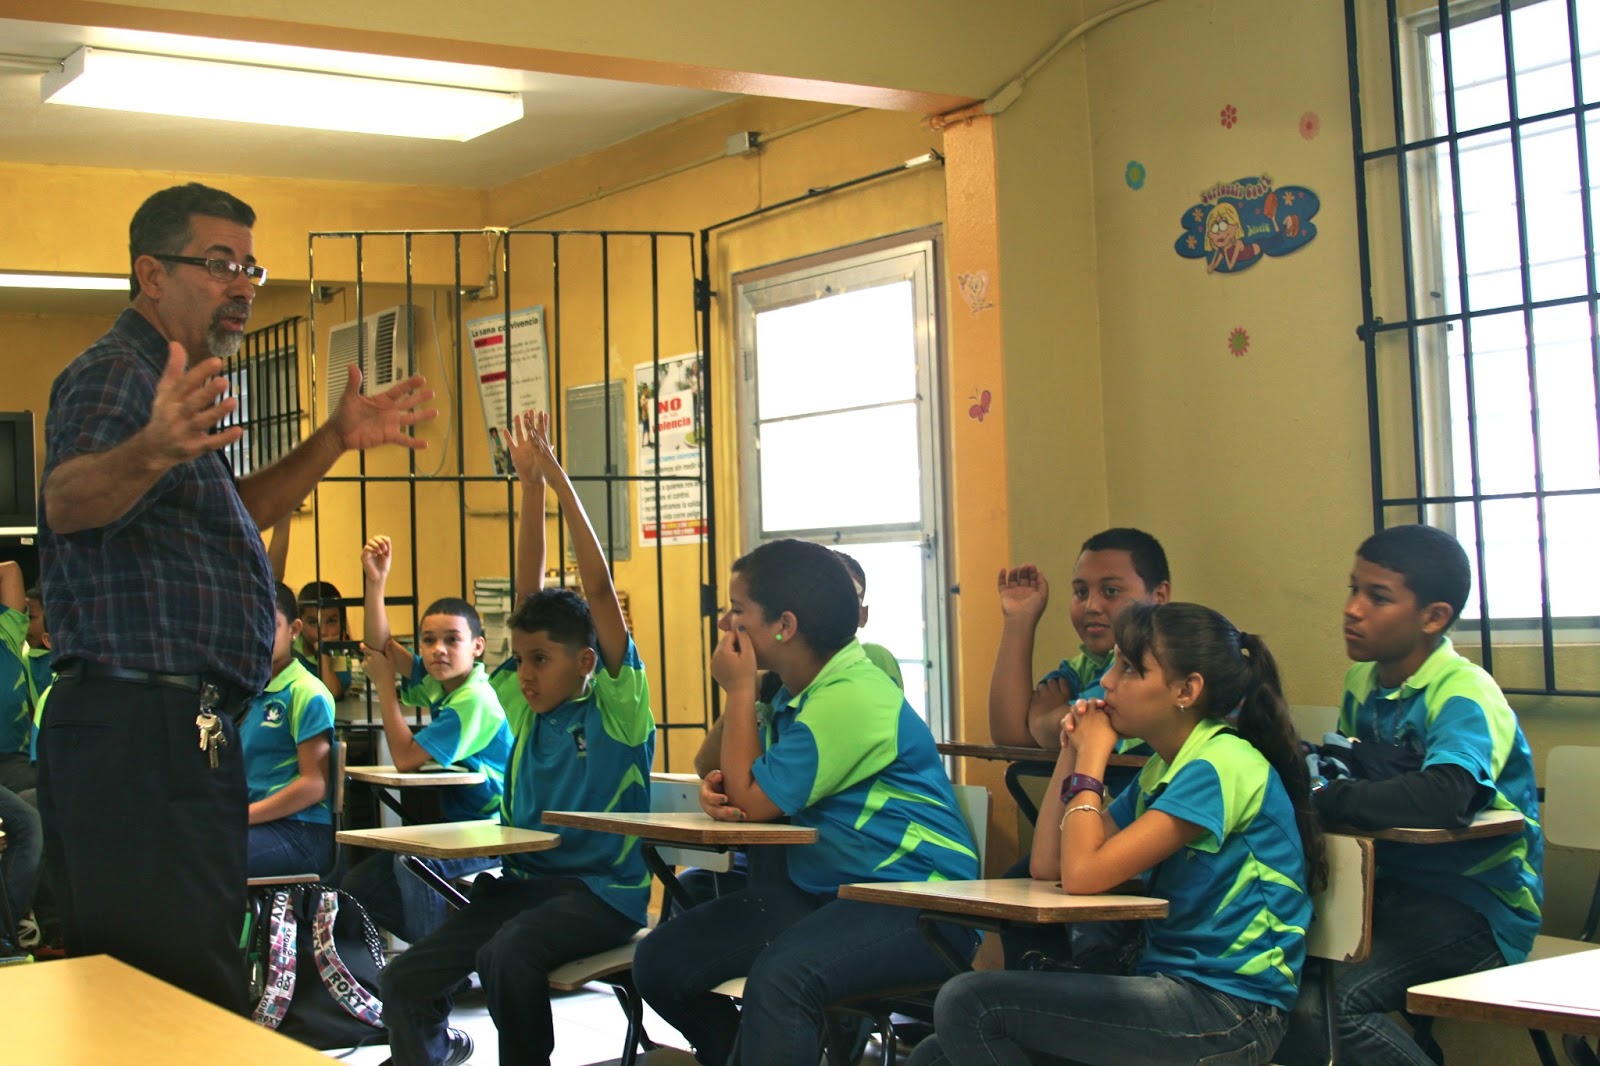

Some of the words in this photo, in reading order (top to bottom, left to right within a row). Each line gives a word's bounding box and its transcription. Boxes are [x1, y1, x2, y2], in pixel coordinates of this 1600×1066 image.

[471, 330, 479, 338] La
[498, 317, 539, 332] covivencia
[657, 397, 682, 414] NO
[271, 893, 288, 921] OXY
[328, 972, 366, 1007] ROXY
[258, 991, 271, 1013] ROXY
